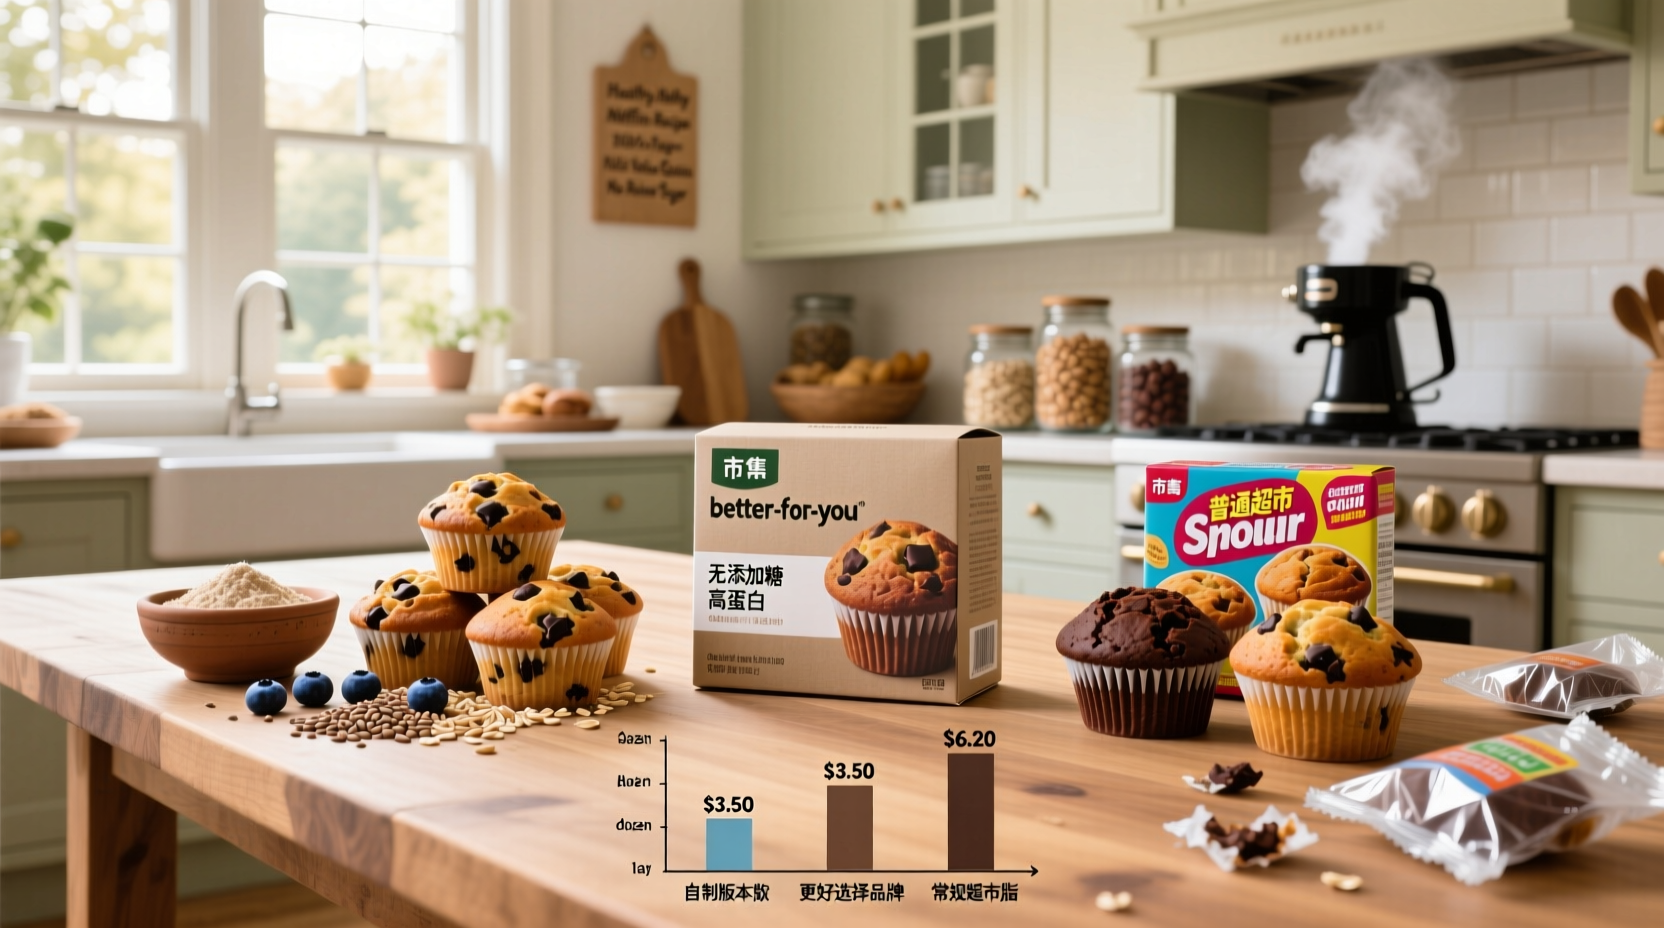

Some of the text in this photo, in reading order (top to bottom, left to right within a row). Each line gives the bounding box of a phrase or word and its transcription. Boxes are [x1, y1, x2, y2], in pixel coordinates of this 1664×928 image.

[723, 456, 767, 480] 市集
[709, 563, 783, 587] 无添加糖
[709, 588, 765, 611] 高蛋白
